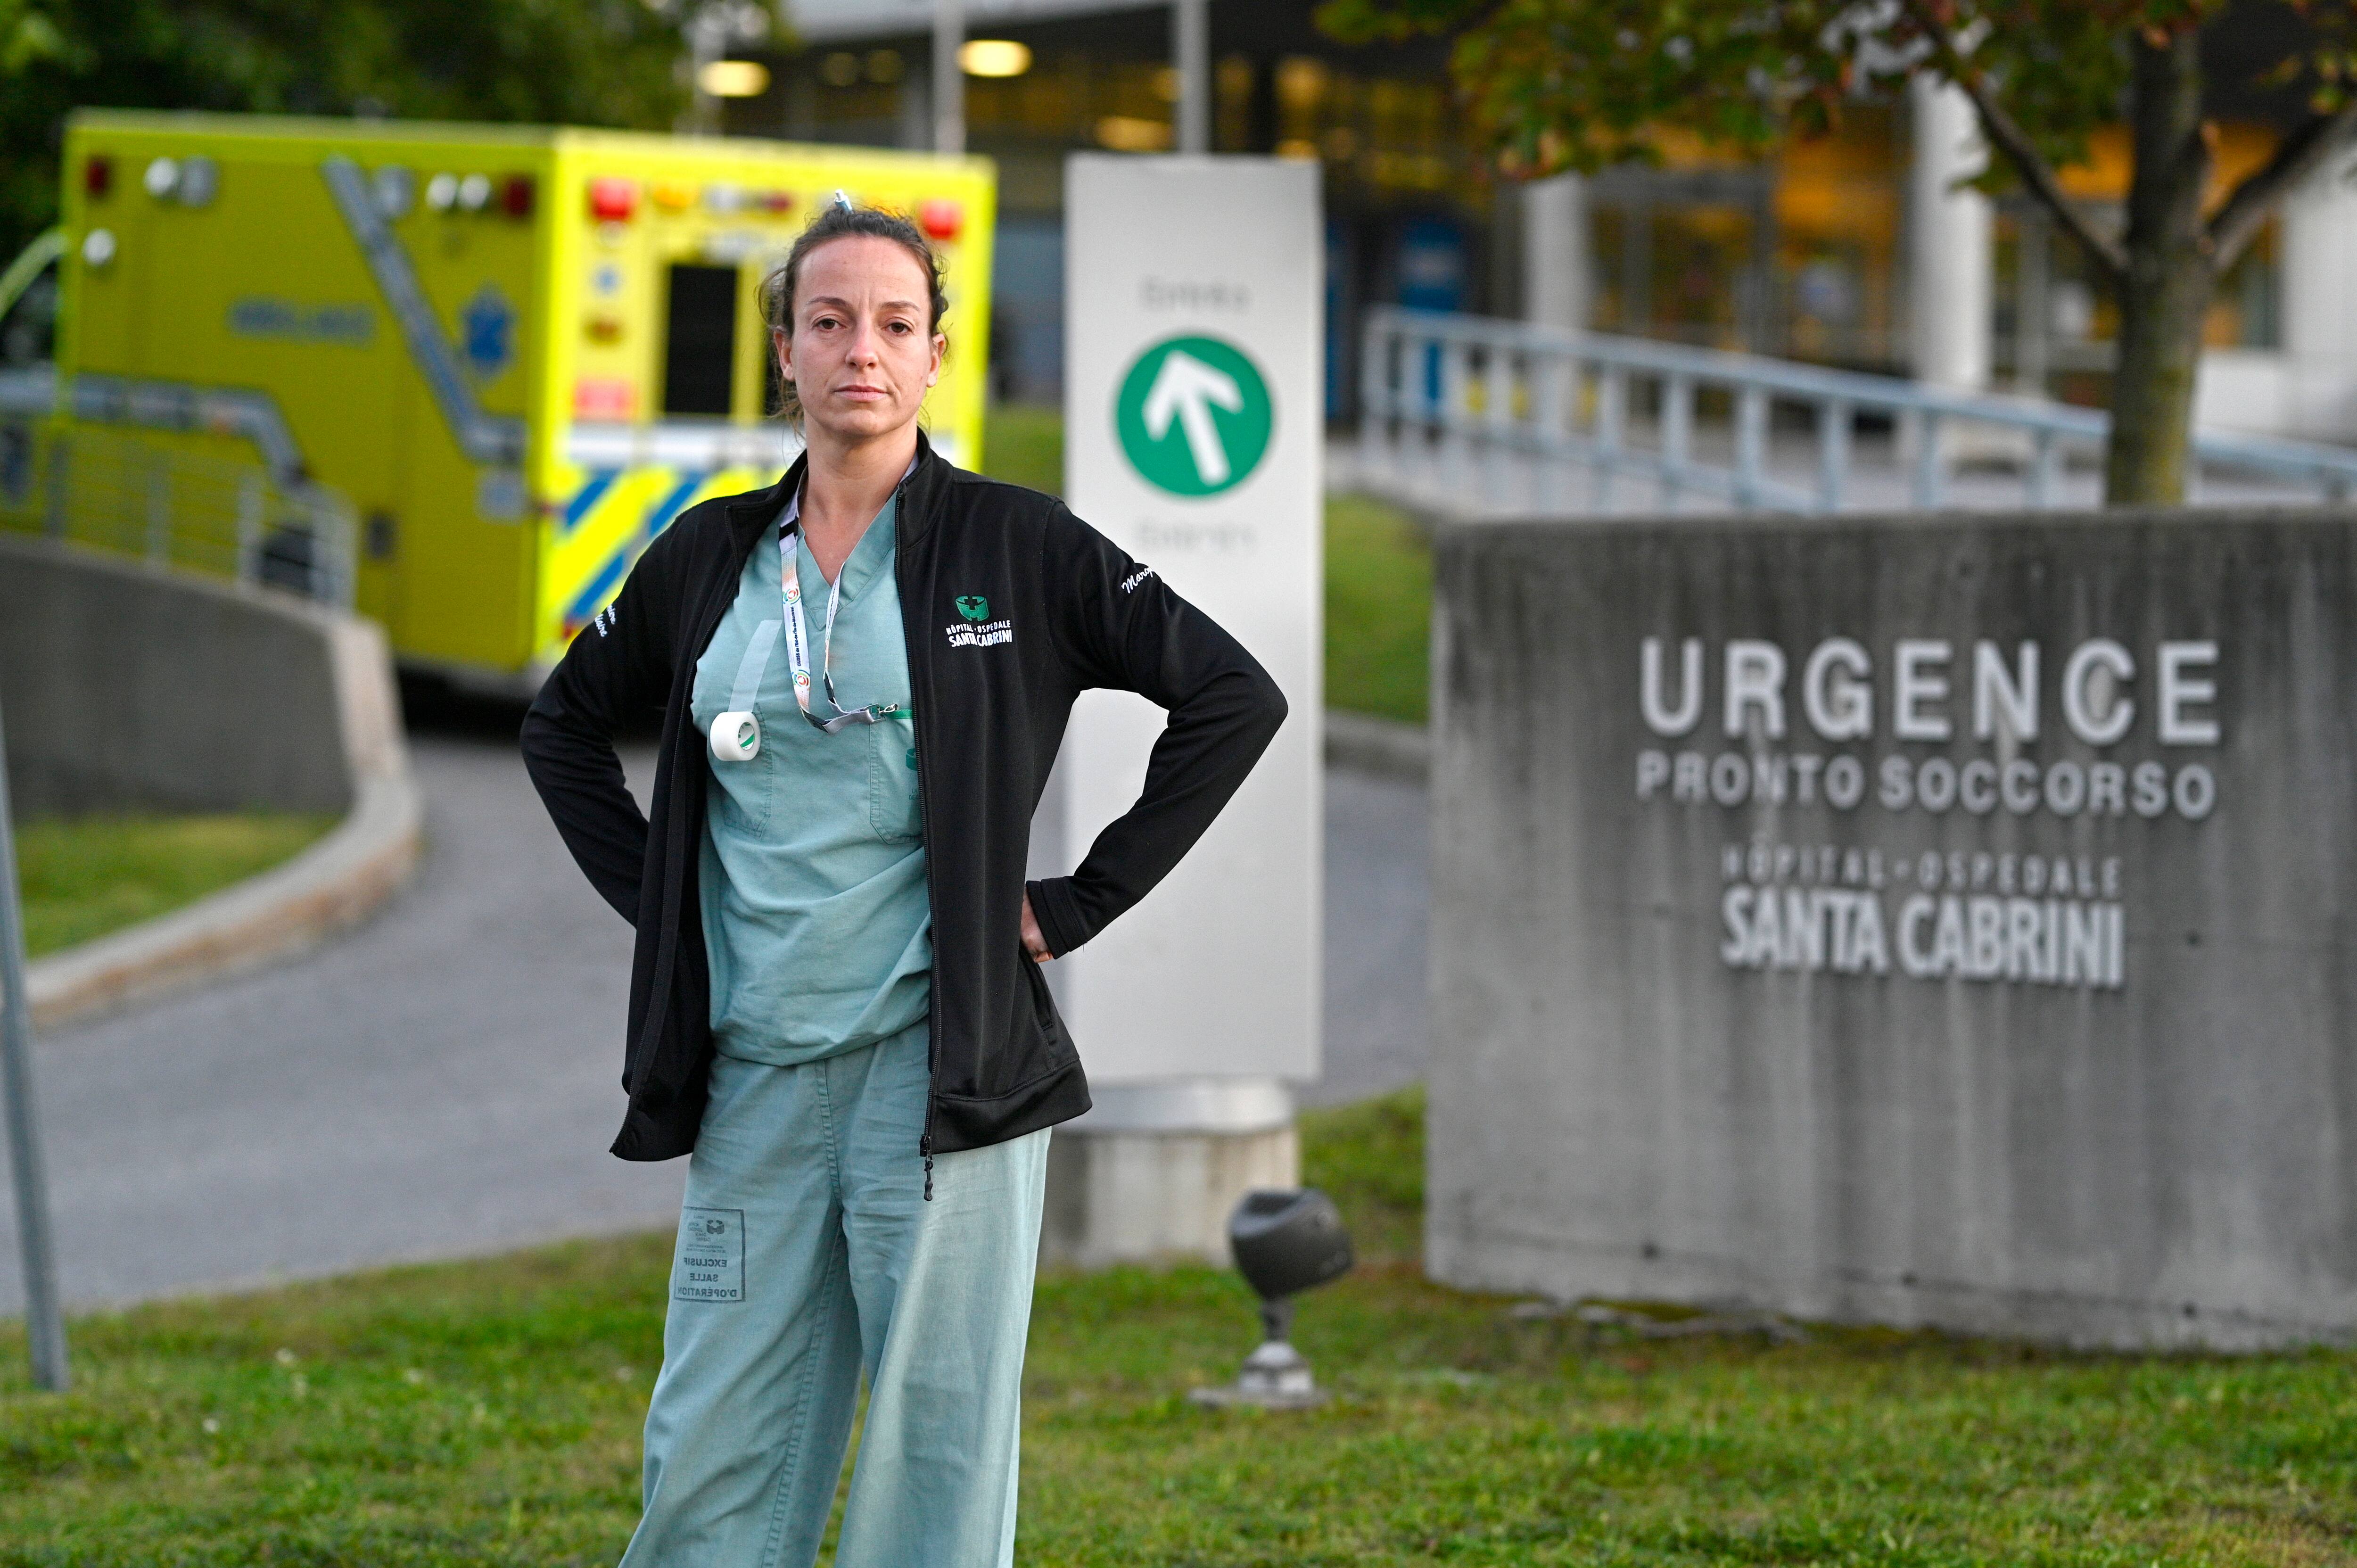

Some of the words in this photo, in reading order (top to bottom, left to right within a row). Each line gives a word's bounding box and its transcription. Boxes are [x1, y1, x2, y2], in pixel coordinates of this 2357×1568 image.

[946, 623, 973, 635] HÔPITAL
[977, 620, 1011, 633] OSPEDALE
[948, 632, 978, 647] SANTA
[976, 629, 1012, 647] CABRINI
[1638, 635, 2221, 746] URGENCE
[1636, 750, 1865, 810] PRONTO
[1879, 755, 2217, 819] SOCCORSO
[1918, 851, 2123, 898] OSPEDALE
[1721, 883, 1888, 973] SANTA
[1897, 892, 2125, 989] CABRINI
